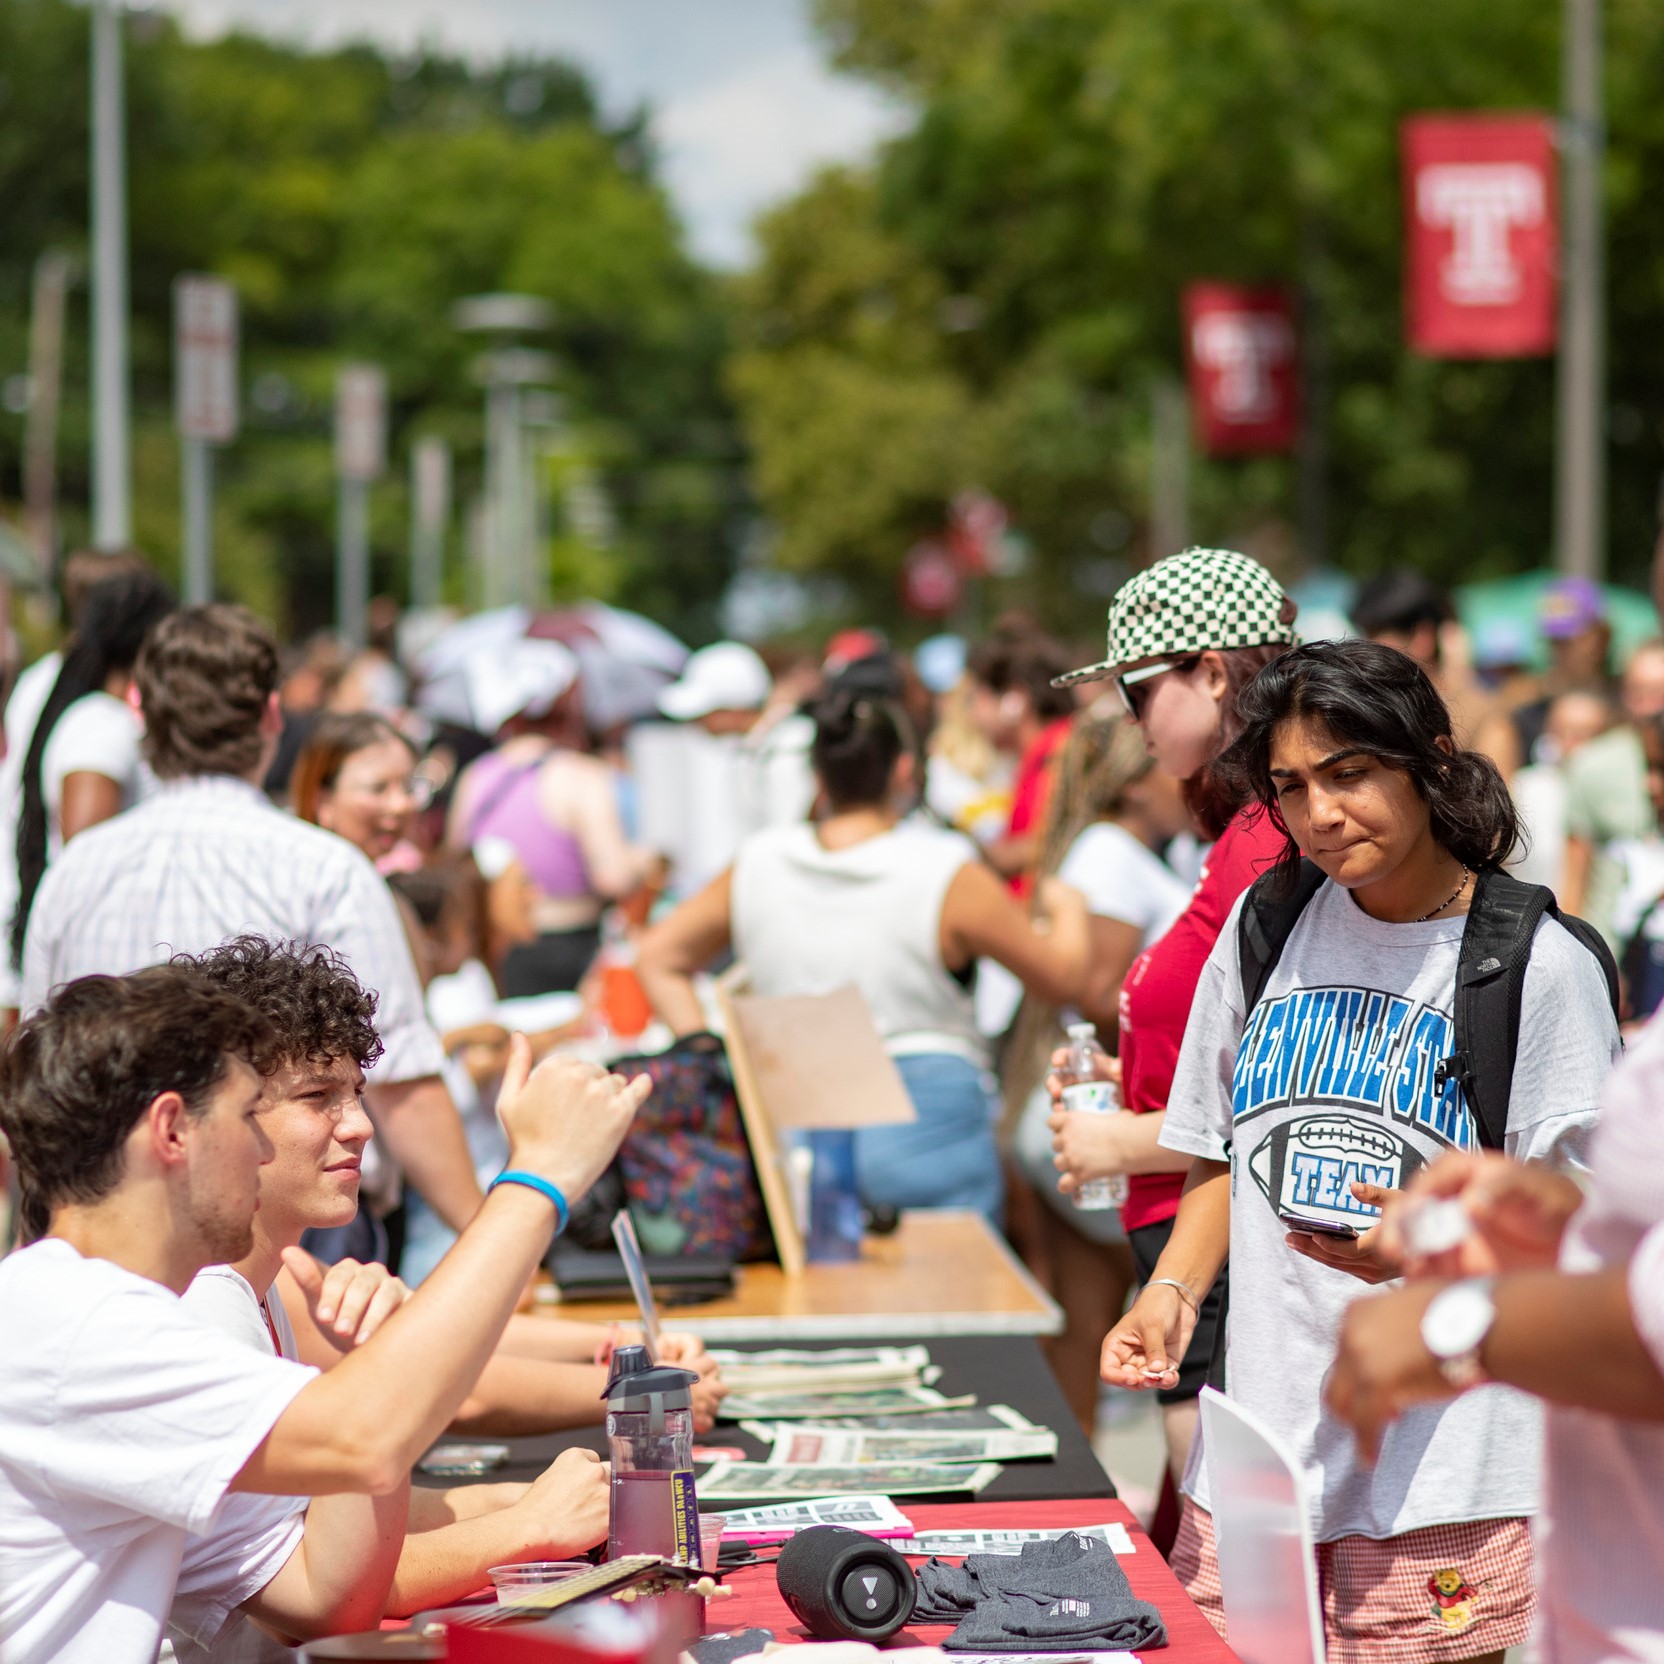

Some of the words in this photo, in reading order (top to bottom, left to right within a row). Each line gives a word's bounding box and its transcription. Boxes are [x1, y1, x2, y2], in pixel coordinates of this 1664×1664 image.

[1416, 162, 1545, 307] T
[1191, 310, 1294, 425] T
[677, 1510, 688, 1544] ABILITIES
